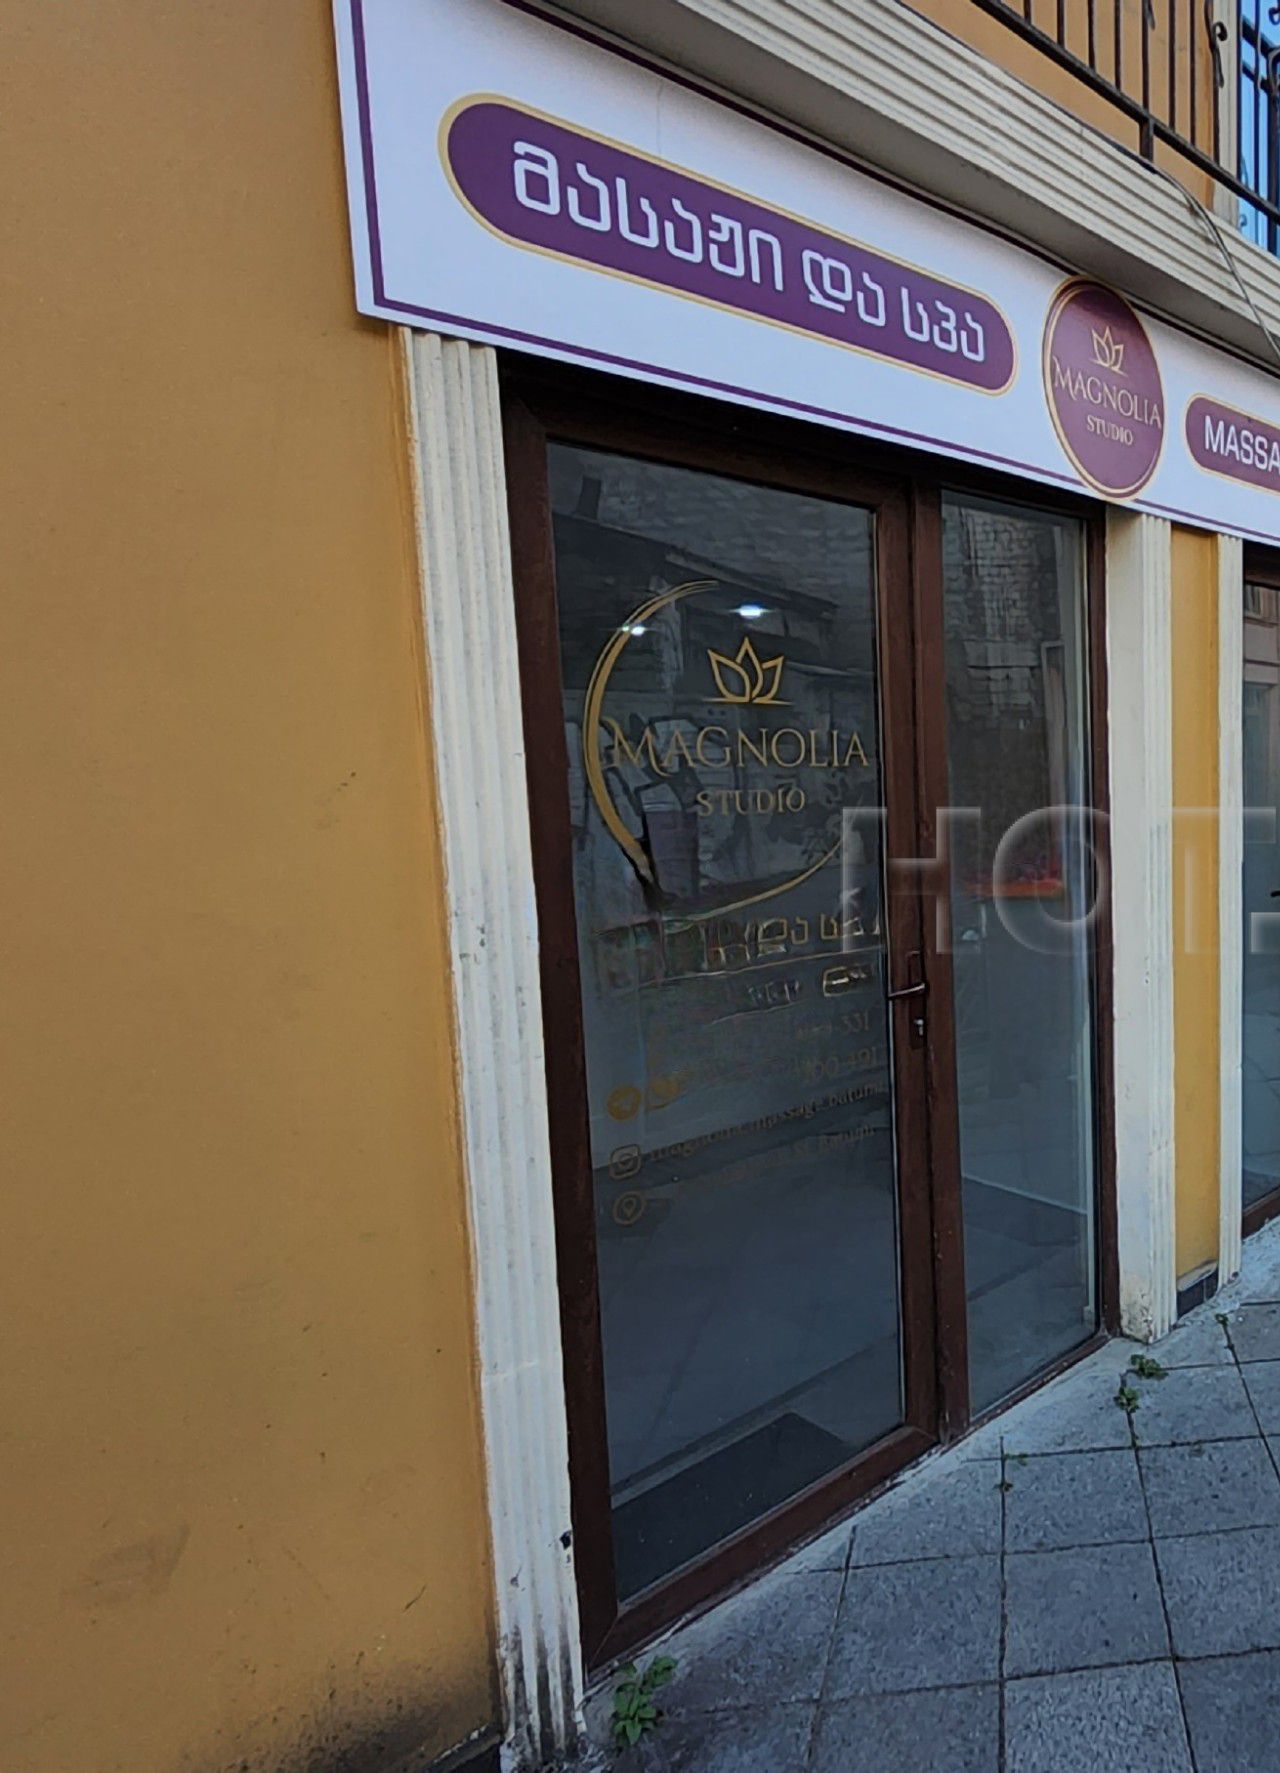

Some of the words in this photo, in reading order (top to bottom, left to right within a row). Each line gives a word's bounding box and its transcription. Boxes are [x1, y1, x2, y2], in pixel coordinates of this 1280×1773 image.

[513, 140, 784, 292] მასაჟი
[802, 249, 886, 327] და
[901, 287, 986, 363] სპა
[1052, 355, 1162, 430] MAGNOLIA
[1087, 414, 1134, 446] STUDIO
[601, 716, 870, 777] MAGNOLIA
[696, 786, 805, 817] STUDIO
